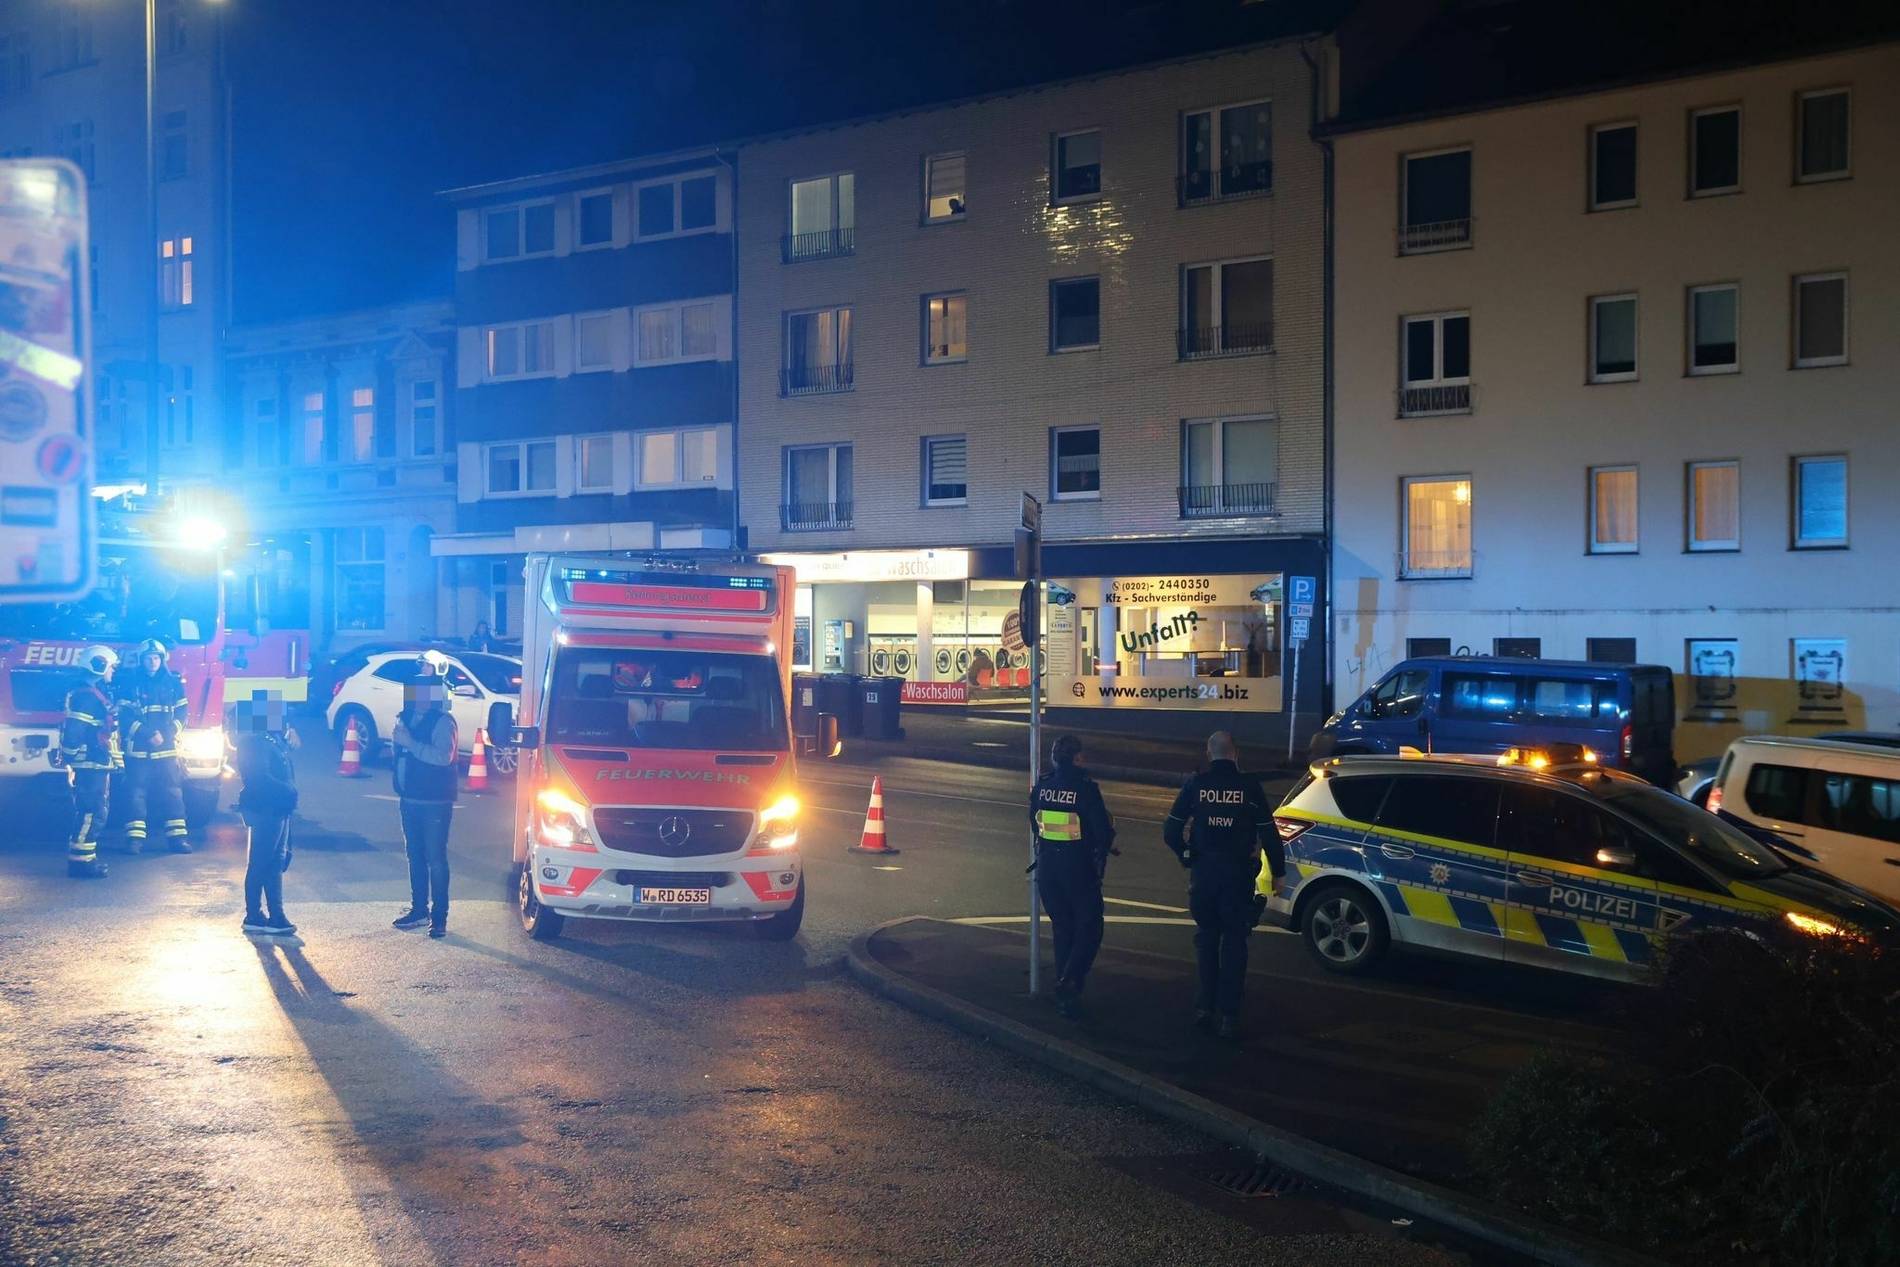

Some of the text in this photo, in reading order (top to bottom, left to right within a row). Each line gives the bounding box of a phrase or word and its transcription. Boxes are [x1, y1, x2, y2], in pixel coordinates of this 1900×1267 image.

[1159, 579, 1210, 589] 2440350
[1296, 580, 1309, 600] P
[1105, 593, 1121, 603] Kfz
[1132, 592, 1217, 604] Sachverständige
[1121, 611, 1198, 653] Unfall?
[1099, 684, 1248, 701] www.experts24.biz
[596, 768, 750, 785] FEUERWEHR
[1039, 788, 1077, 805] POLIZEI
[1200, 789, 1244, 804] POLIZEI
[1208, 815, 1233, 827] NRW
[642, 890, 708, 902] W RD 6535
[1549, 886, 1637, 919] POLIZEI
